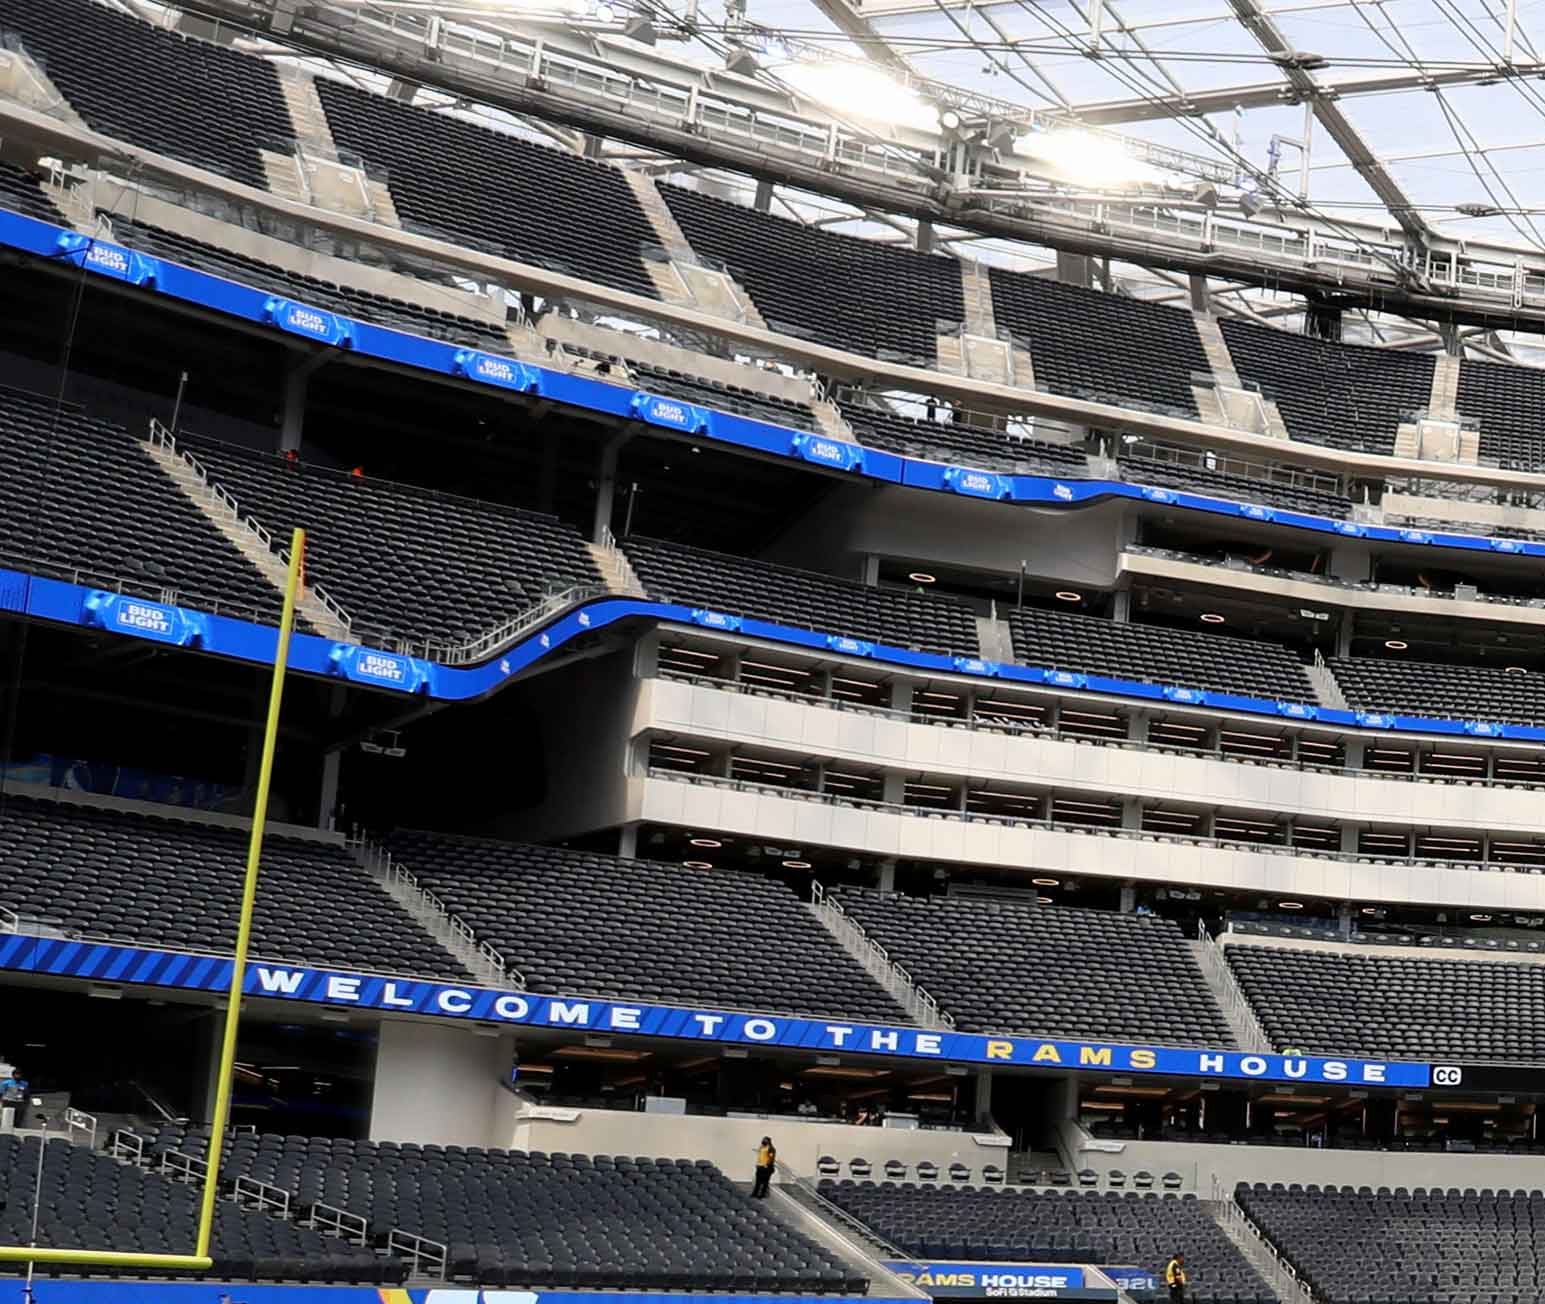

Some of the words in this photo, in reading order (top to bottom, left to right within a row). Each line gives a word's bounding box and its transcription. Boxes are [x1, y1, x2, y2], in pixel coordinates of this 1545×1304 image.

[290, 316, 326, 332] LIGHT
[296, 310, 322, 323] BUD
[480, 366, 514, 380] LIGHT
[485, 360, 509, 372] BUD
[129, 604, 164, 620] BUD
[120, 612, 169, 631] LIGHT
[366, 655, 397, 668] BUD
[360, 662, 401, 679] LIGHT
[256, 967, 641, 1030] WELCOME
[696, 1015, 777, 1041] TO
[825, 1026, 942, 1054] THE
[986, 1042, 1157, 1069] RAMS
[1199, 1054, 1387, 1082] HOUSE
[1436, 1068, 1460, 1083] CC
[981, 1274, 1068, 1288] HOUSE
